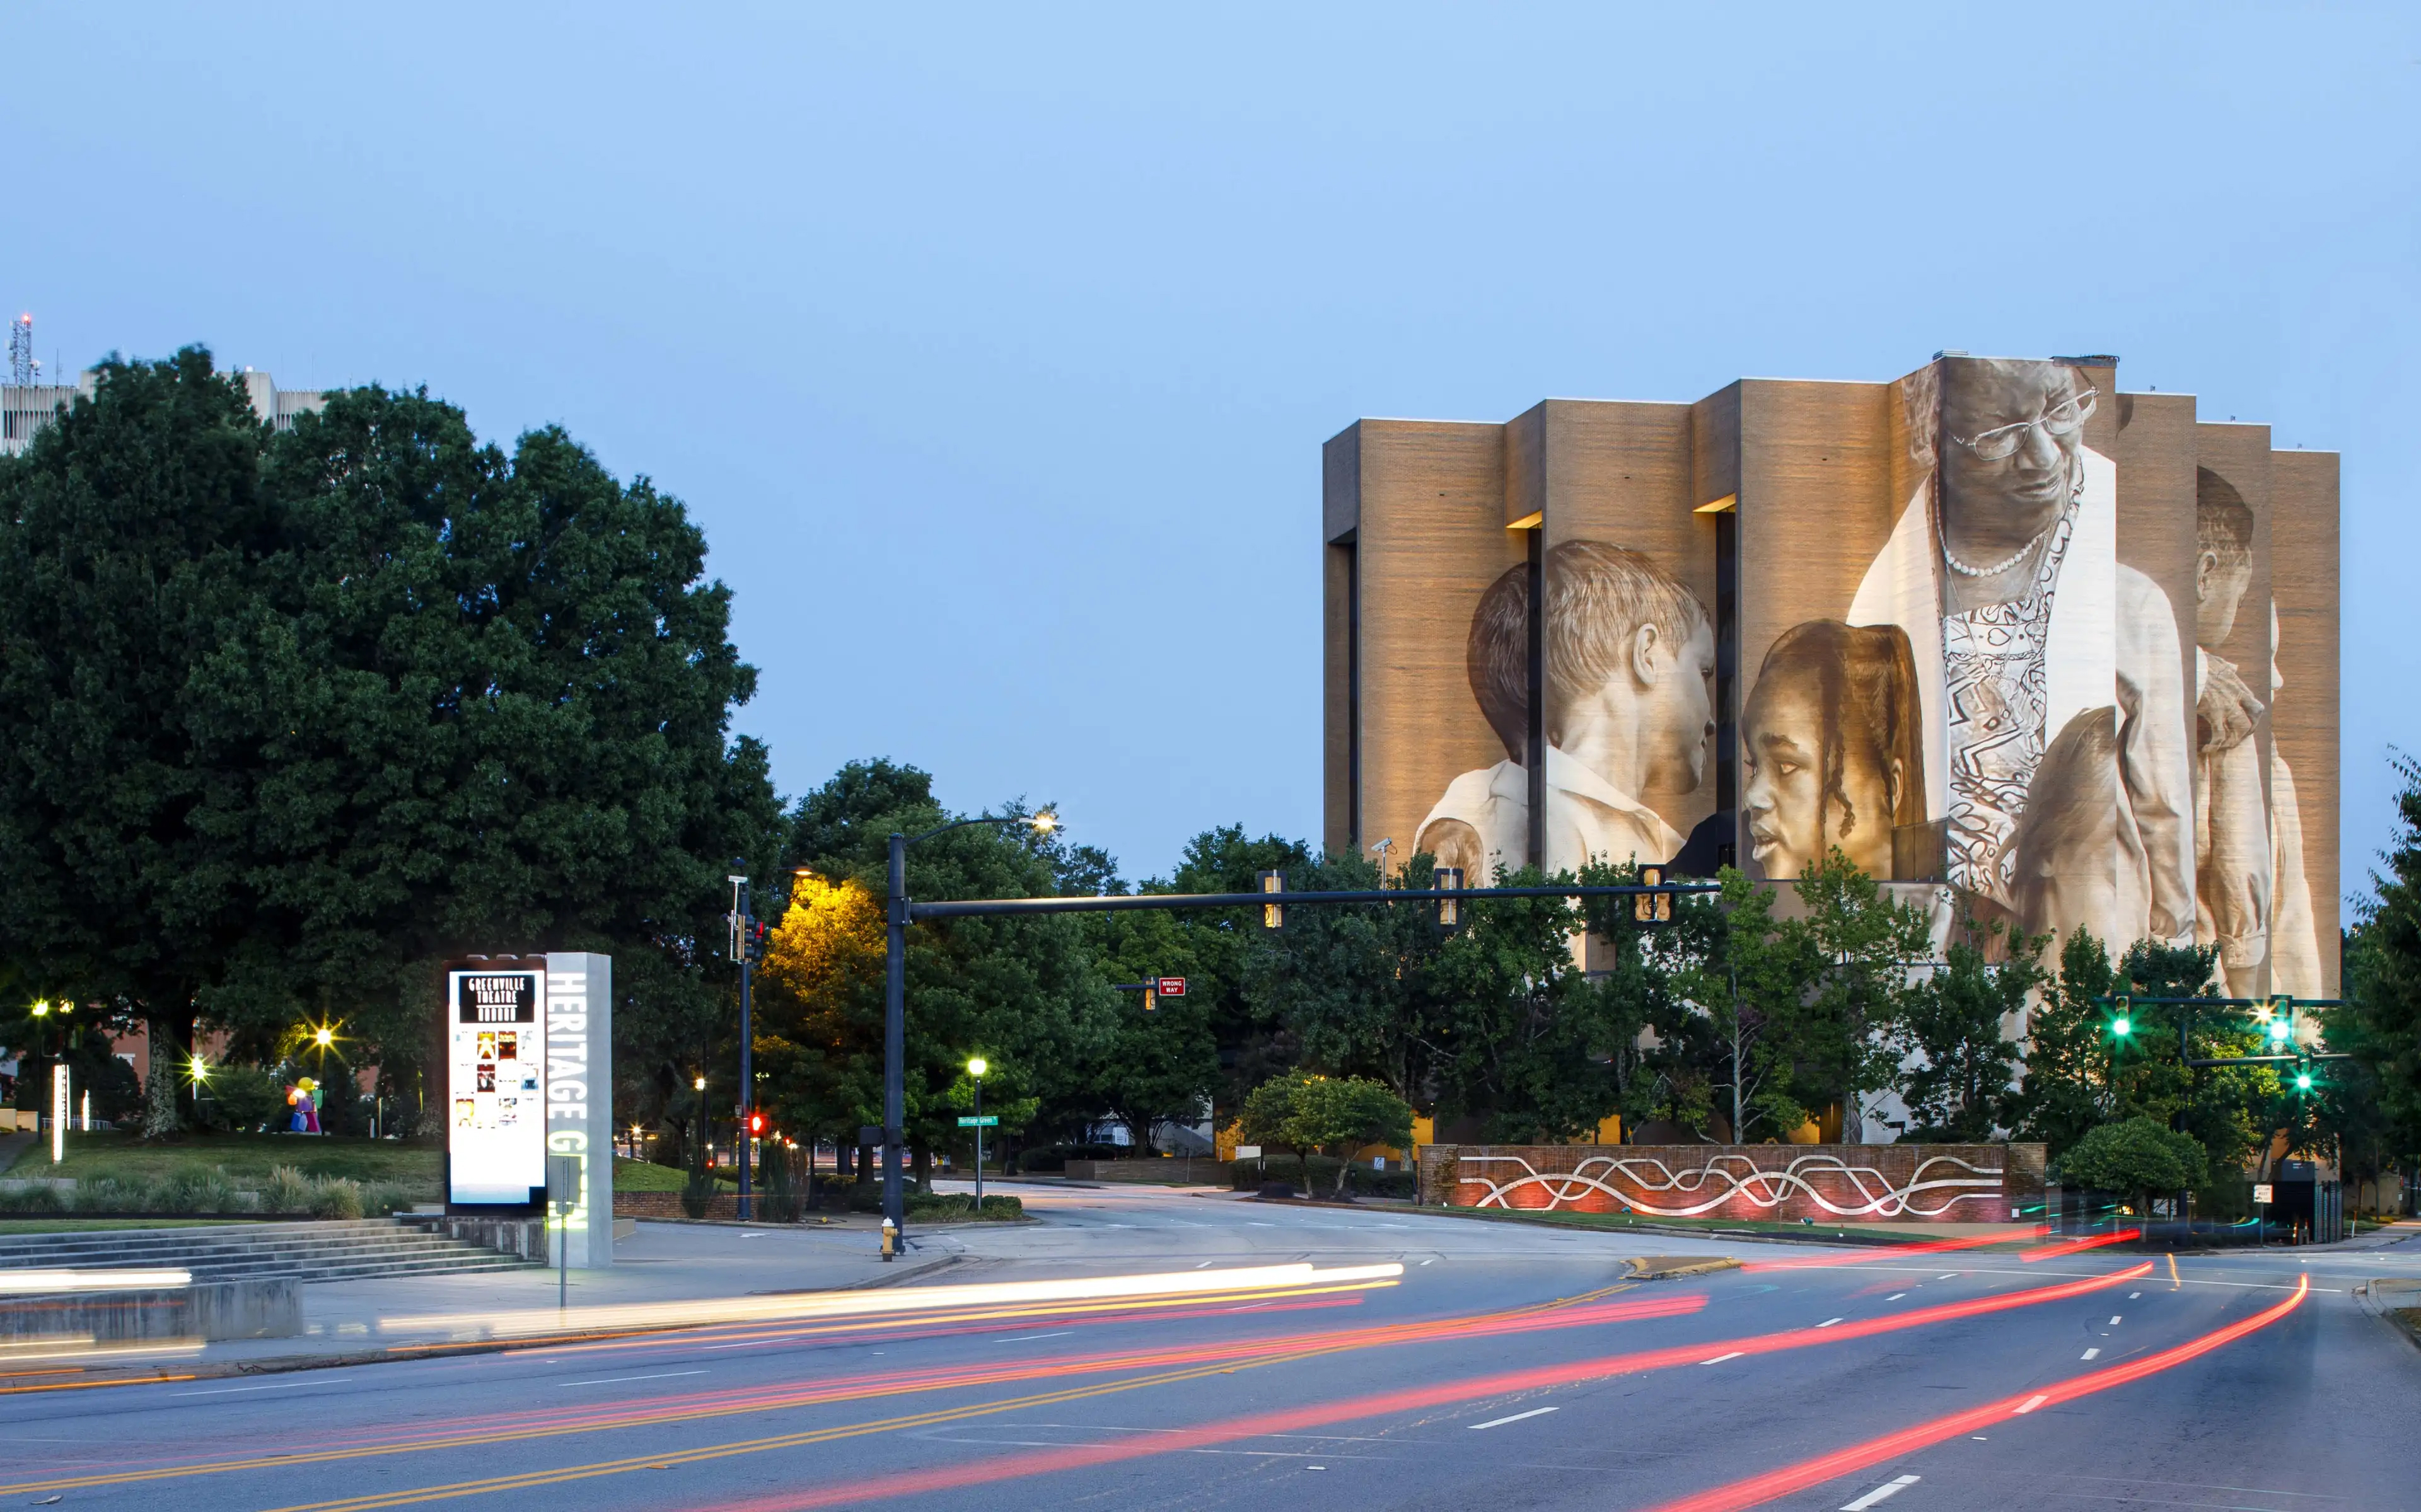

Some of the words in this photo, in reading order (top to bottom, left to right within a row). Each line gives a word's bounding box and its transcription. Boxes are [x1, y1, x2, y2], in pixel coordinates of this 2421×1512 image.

[468, 978, 525, 991] GREENVILLE
[477, 990, 517, 1003] THEATRE
[547, 973, 587, 1119] HERITAGE
[959, 1117, 978, 1126] Heritage
